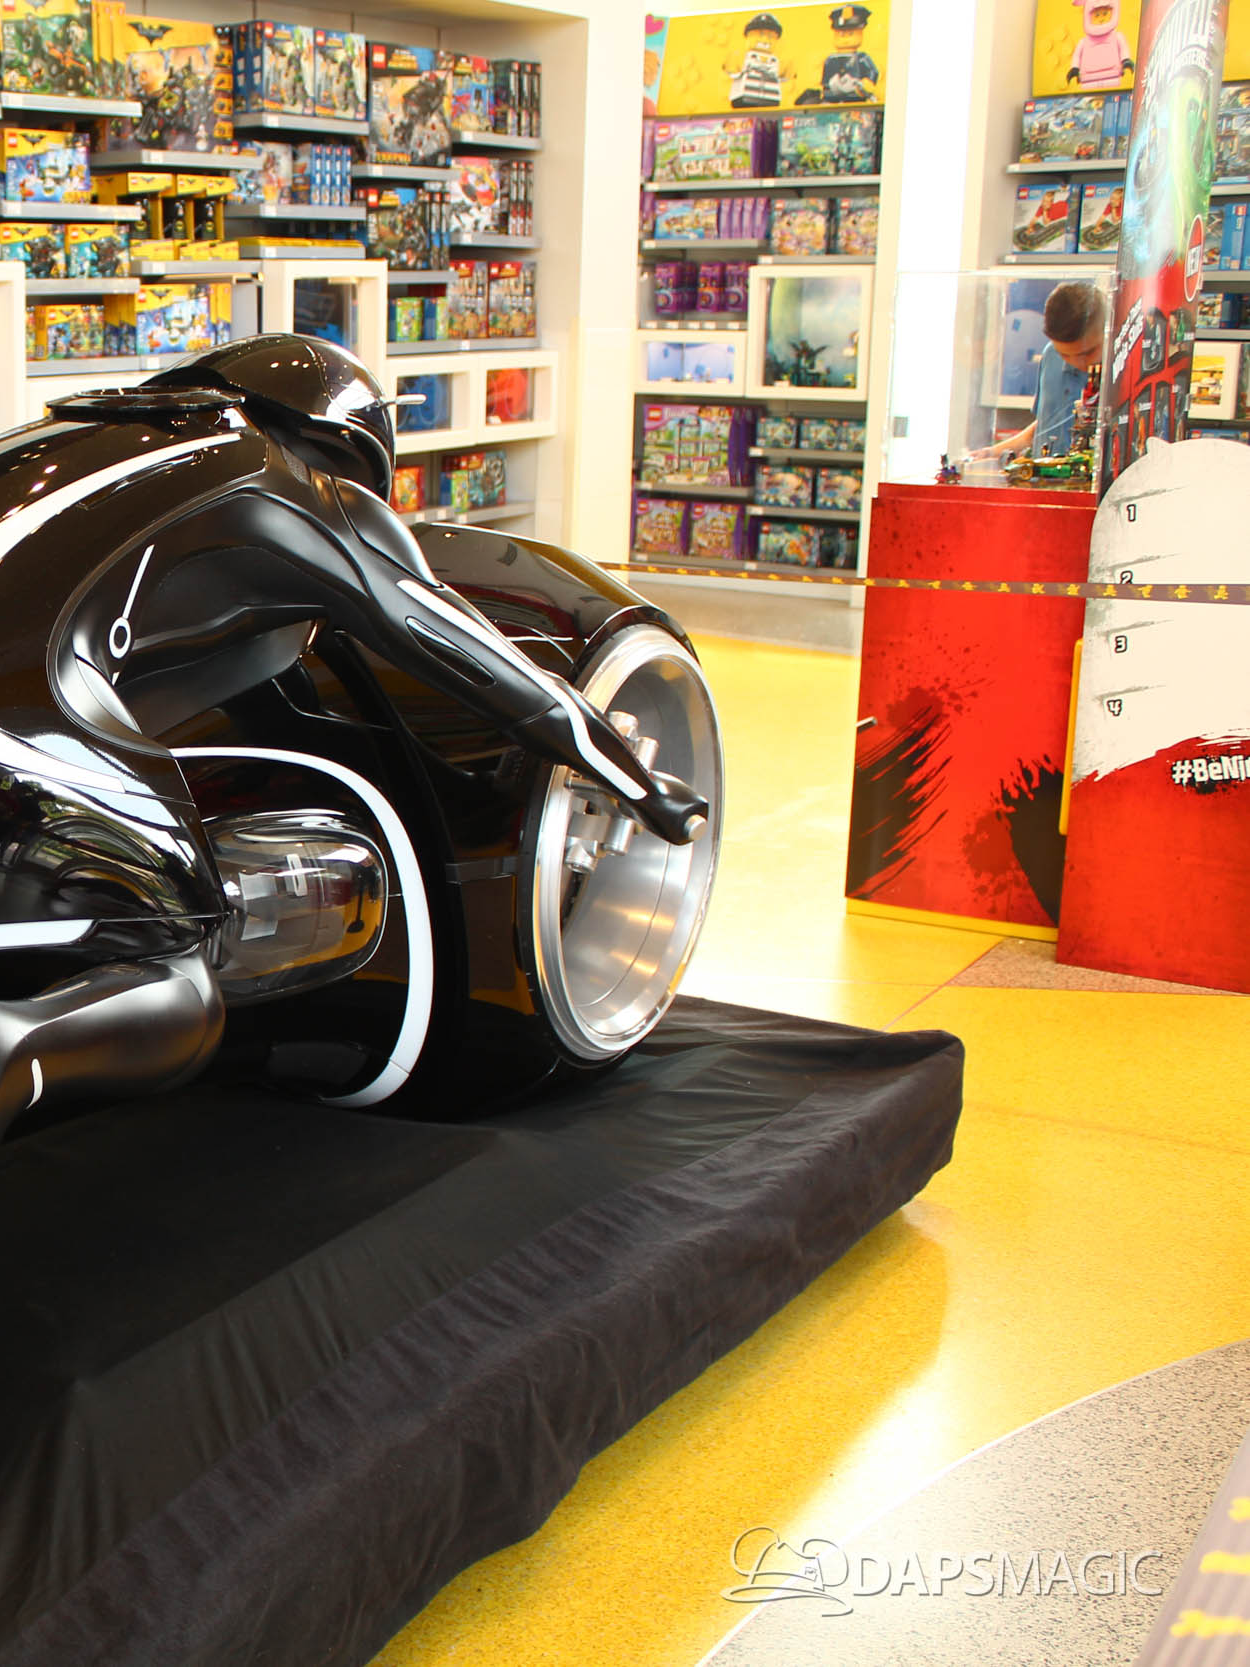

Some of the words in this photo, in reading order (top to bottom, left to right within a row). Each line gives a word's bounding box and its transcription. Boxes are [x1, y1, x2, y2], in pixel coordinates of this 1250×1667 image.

[1126, 504, 1137, 522] 1
[1120, 571, 1133, 584] 2
[1114, 635, 1128, 653] 3
[1107, 699, 1122, 716] 4
